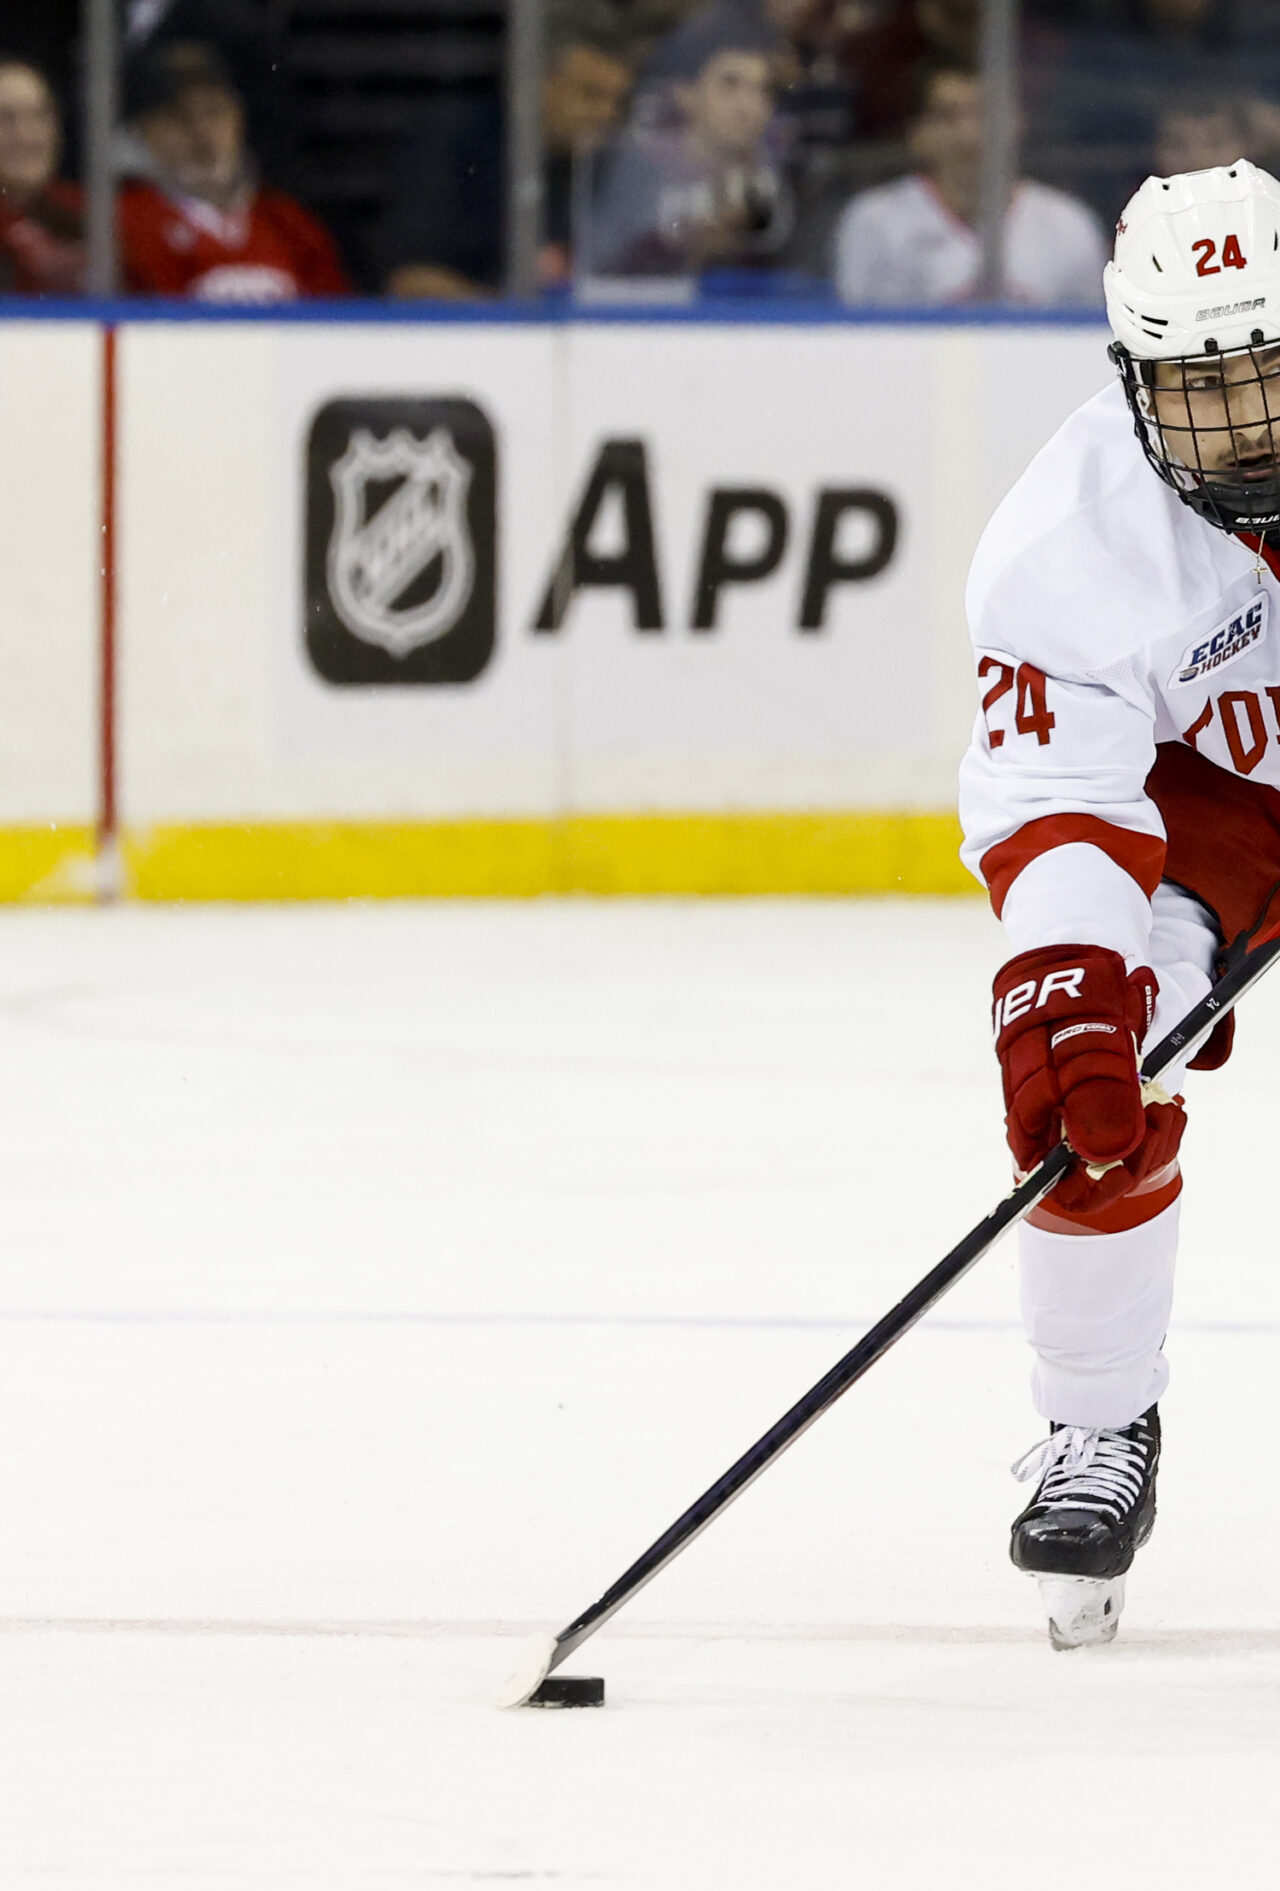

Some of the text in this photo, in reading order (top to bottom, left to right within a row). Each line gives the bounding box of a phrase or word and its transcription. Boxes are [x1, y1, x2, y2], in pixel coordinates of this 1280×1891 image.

[1191, 234, 1248, 277] 24
[1195, 297, 1266, 321] BAUER
[1188, 601, 1263, 667] ECAC
[1200, 623, 1263, 674] HOCKEY
[977, 655, 1056, 750] 24
[1205, 997, 1220, 1011] 24
